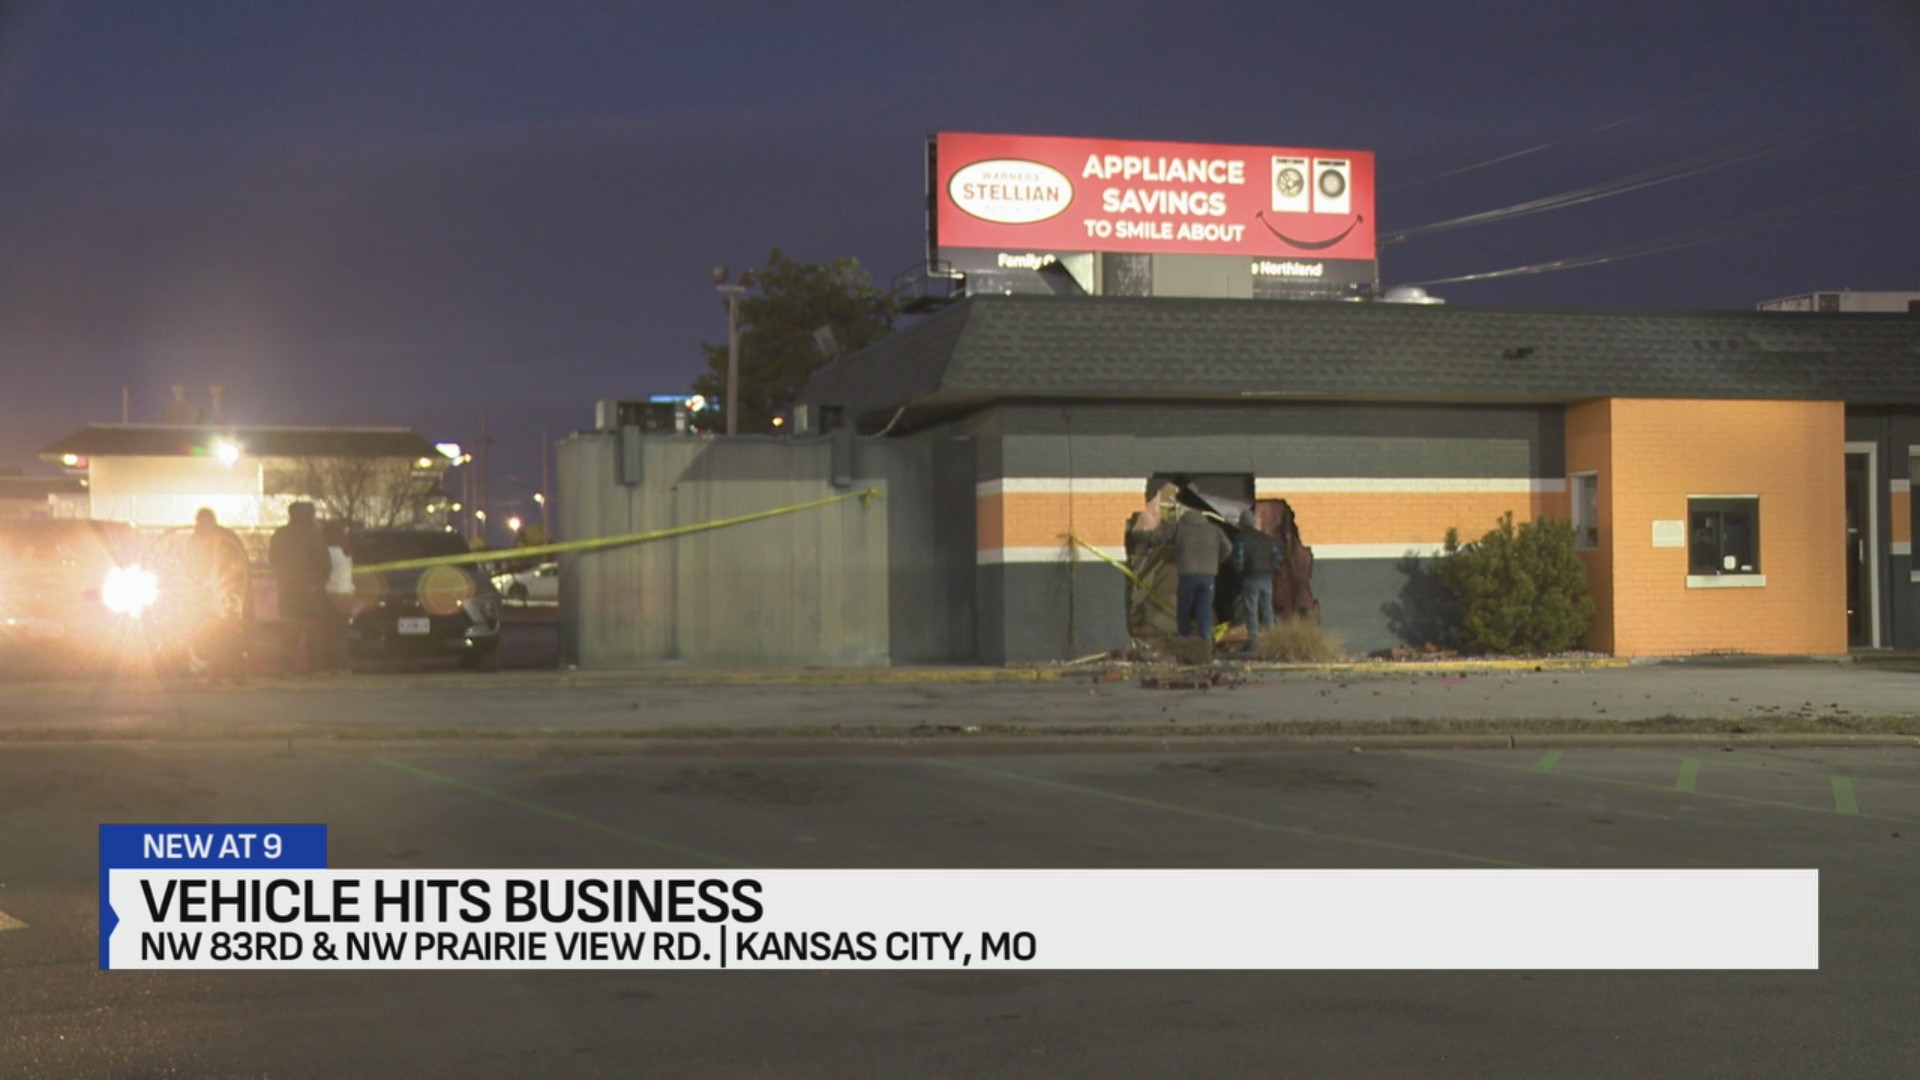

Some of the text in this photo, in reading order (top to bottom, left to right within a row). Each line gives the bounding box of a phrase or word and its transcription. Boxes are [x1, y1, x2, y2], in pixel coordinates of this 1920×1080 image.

[1082, 154, 1245, 185] APPLIANCE
[963, 183, 1059, 202] STELLIAN
[1102, 188, 1226, 216] SAVINGS
[1084, 219, 1245, 242] TO SMILE ABOUT
[998, 252, 1042, 271] Family
[1260, 261, 1323, 276] Northland
